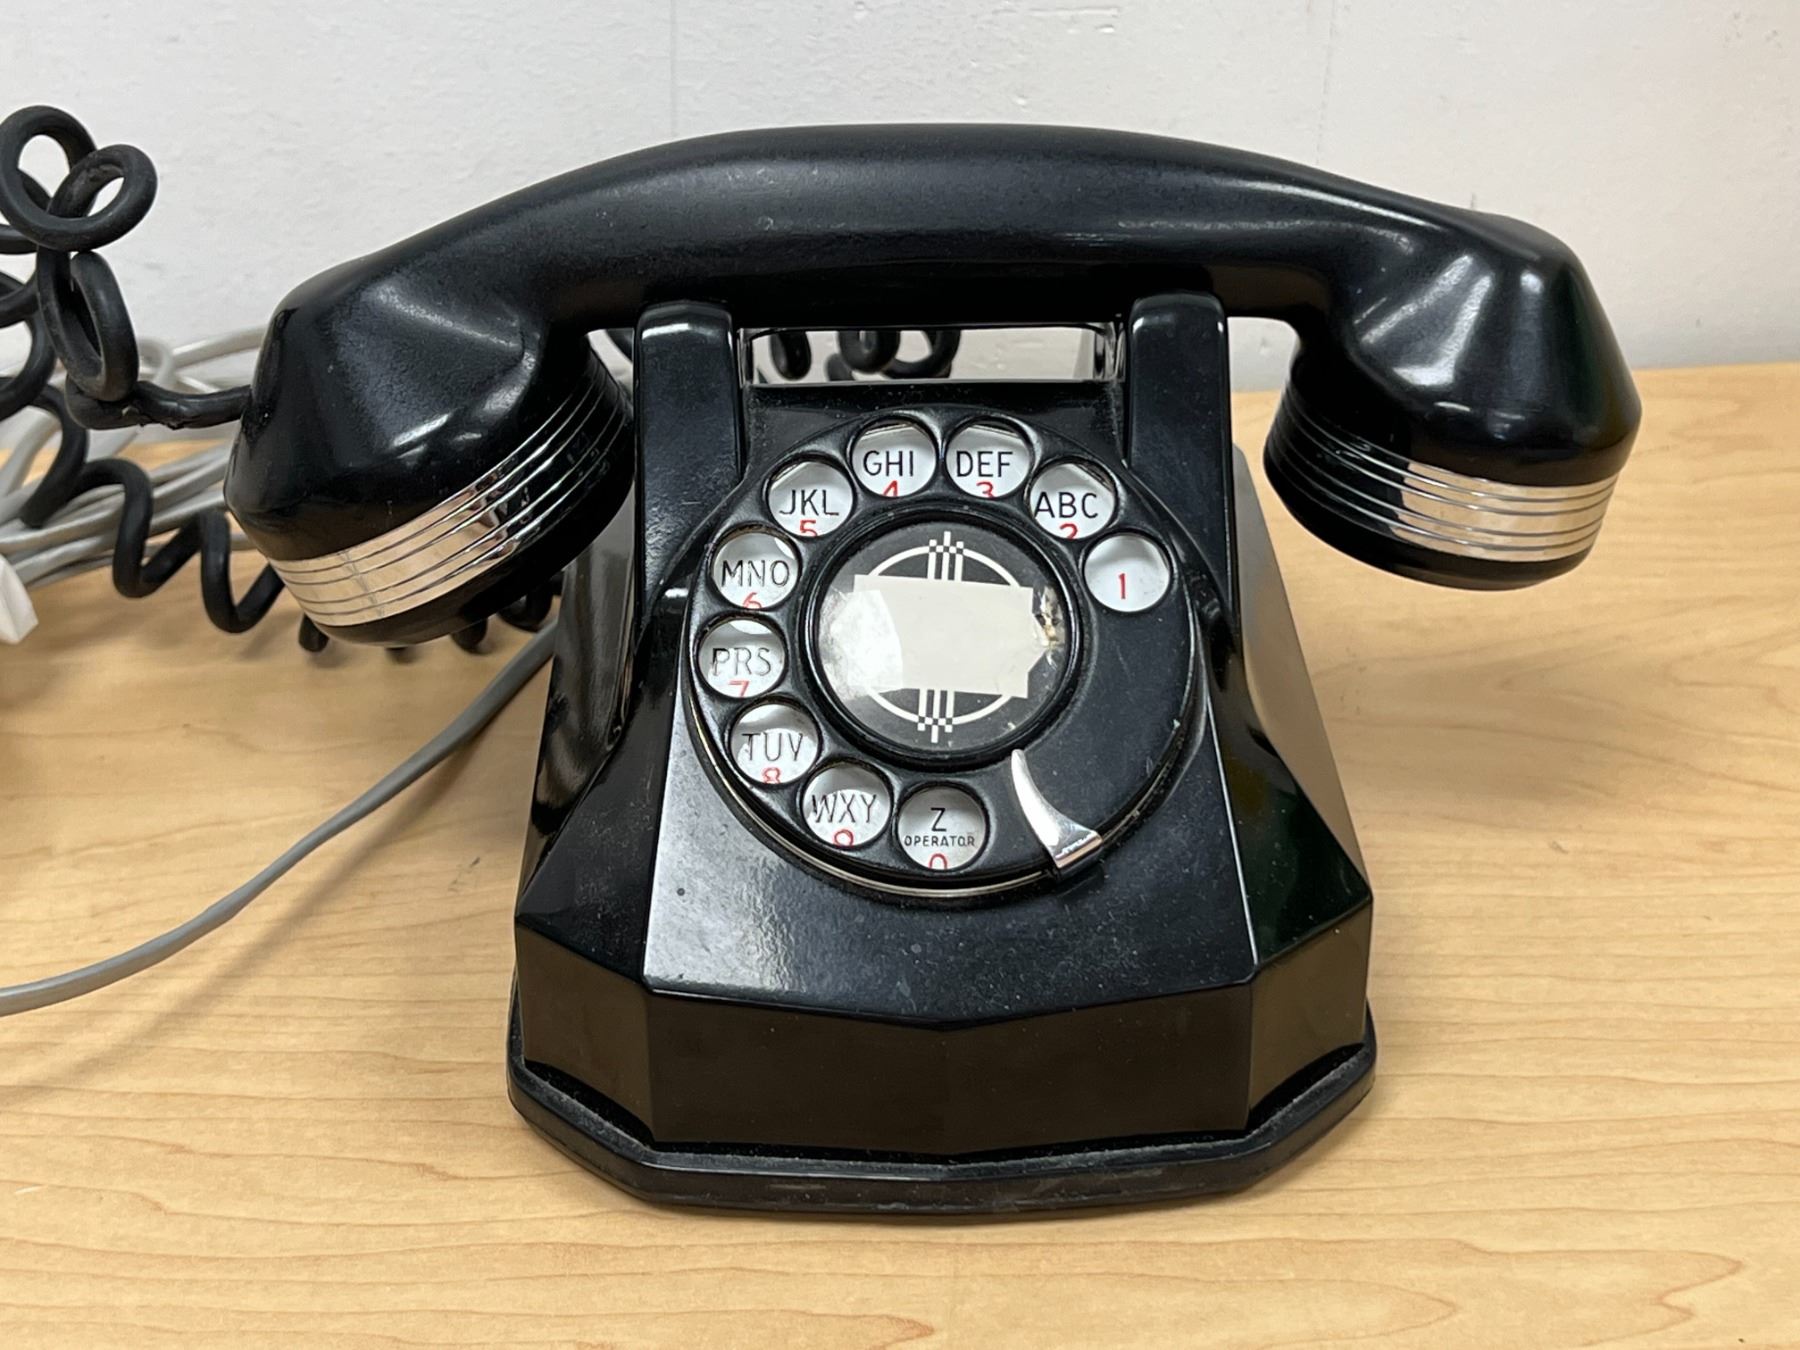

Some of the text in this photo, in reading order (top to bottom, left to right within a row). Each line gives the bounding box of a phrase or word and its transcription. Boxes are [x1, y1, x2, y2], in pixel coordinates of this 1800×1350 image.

[863, 450, 914, 477] GHI
[956, 450, 1014, 478] DEF
[779, 489, 840, 516] JKL
[1034, 491, 1099, 519] ABC
[799, 519, 818, 537] 5
[721, 560, 790, 588] MNO
[1117, 572, 1126, 600] 1
[712, 647, 772, 677] PRS
[728, 680, 750, 698] 7
[741, 732, 804, 762] TUV
[811, 793, 877, 823] WXY
[930, 807, 947, 832] Z
[903, 835, 976, 847] OPERATOR
